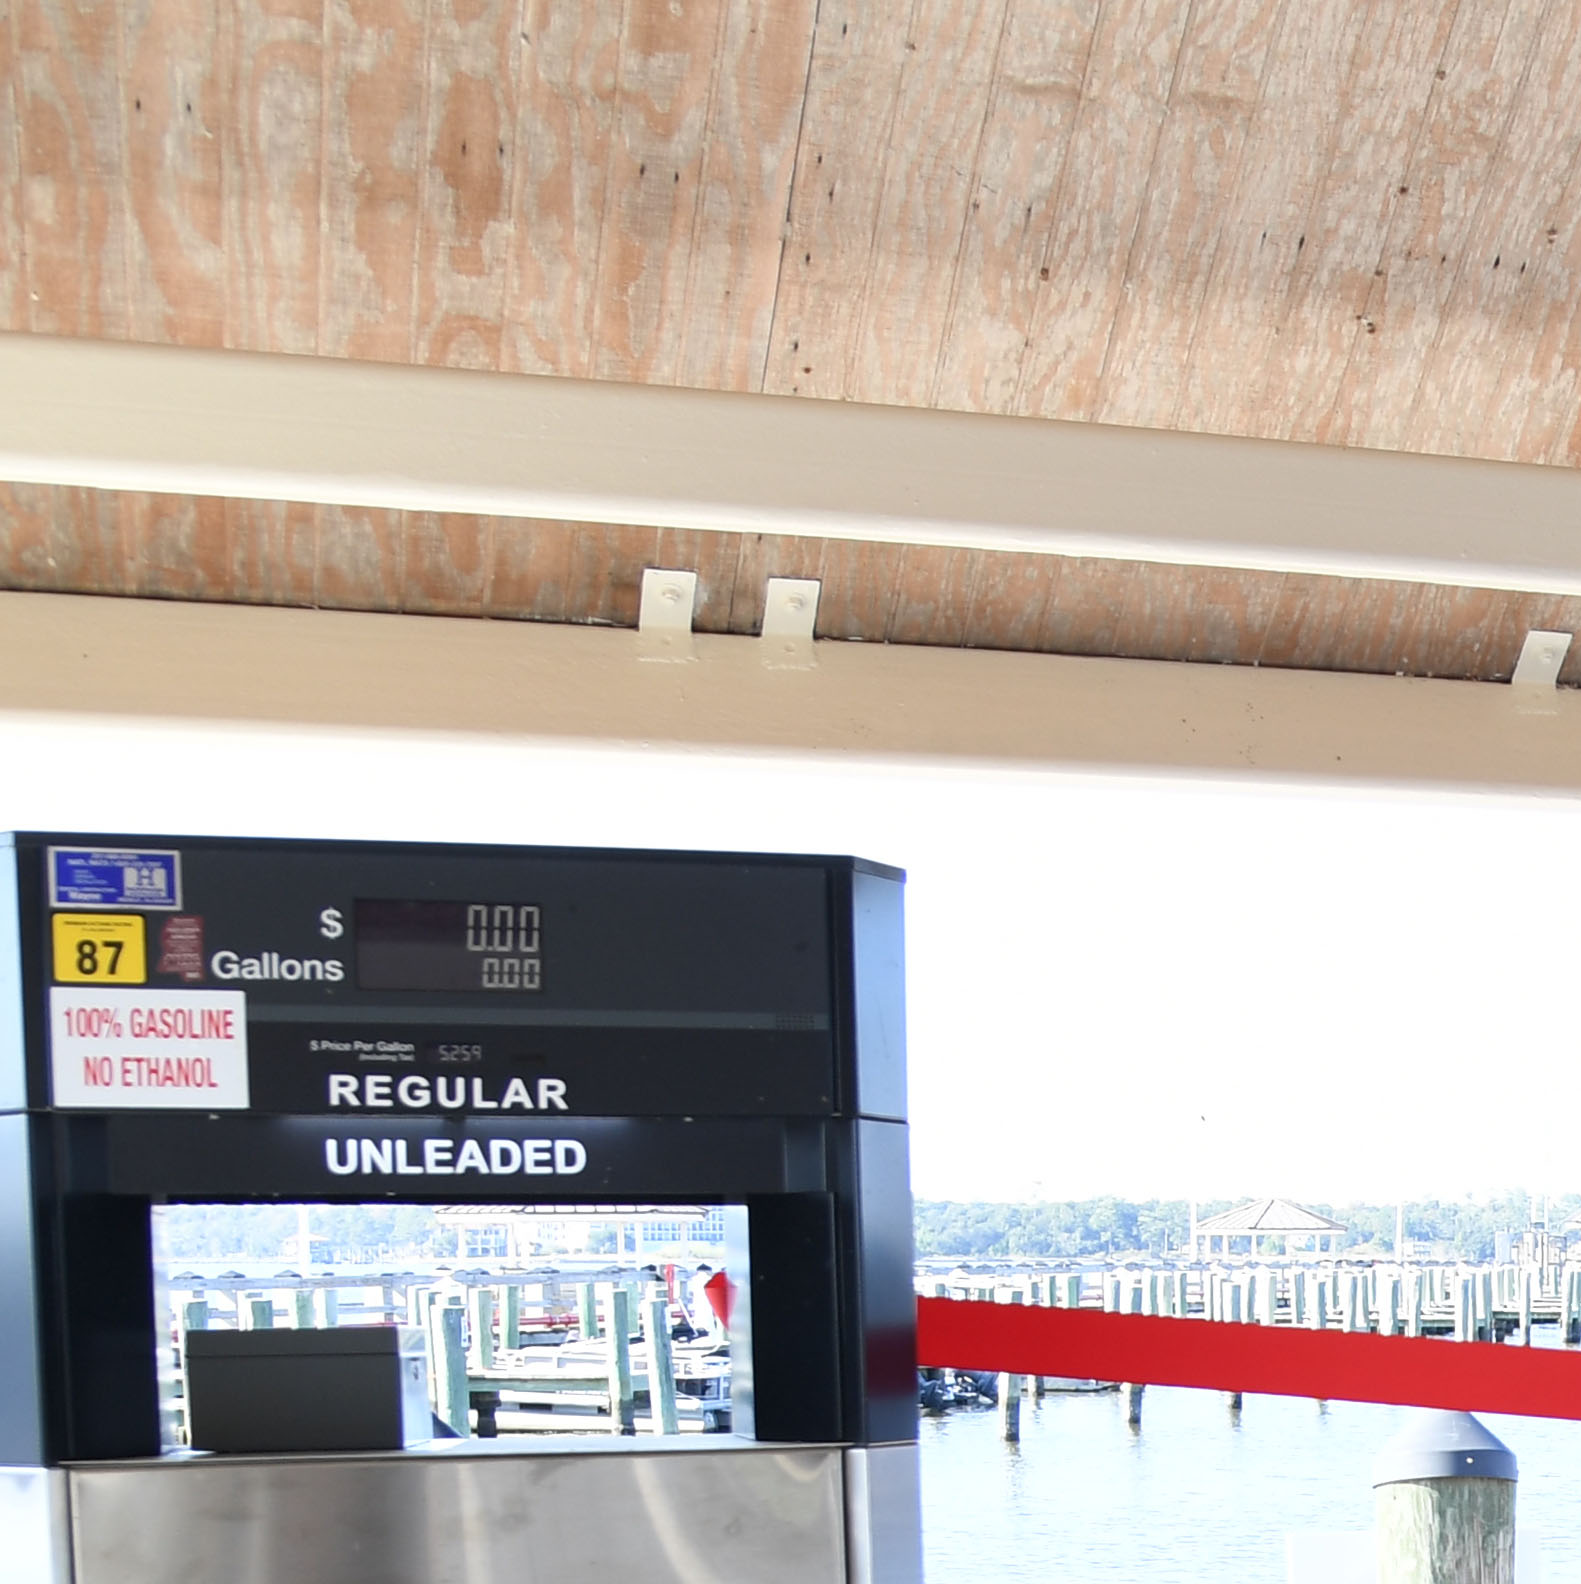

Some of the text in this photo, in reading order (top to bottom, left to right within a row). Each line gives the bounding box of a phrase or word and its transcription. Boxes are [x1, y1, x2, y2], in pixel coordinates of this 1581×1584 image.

[320, 906, 344, 940] $
[76, 939, 125, 976] 87
[211, 950, 345, 981] Gallons
[64, 1007, 235, 1039] 100% GASOLINE
[321, 1040, 351, 1051] Price
[353, 1041, 375, 1052] Per
[376, 1041, 415, 1052] Gallon
[84, 1056, 218, 1088] NO ETHANOL
[328, 1074, 569, 1111] REGULAR
[325, 1138, 588, 1175] UNLEADED
